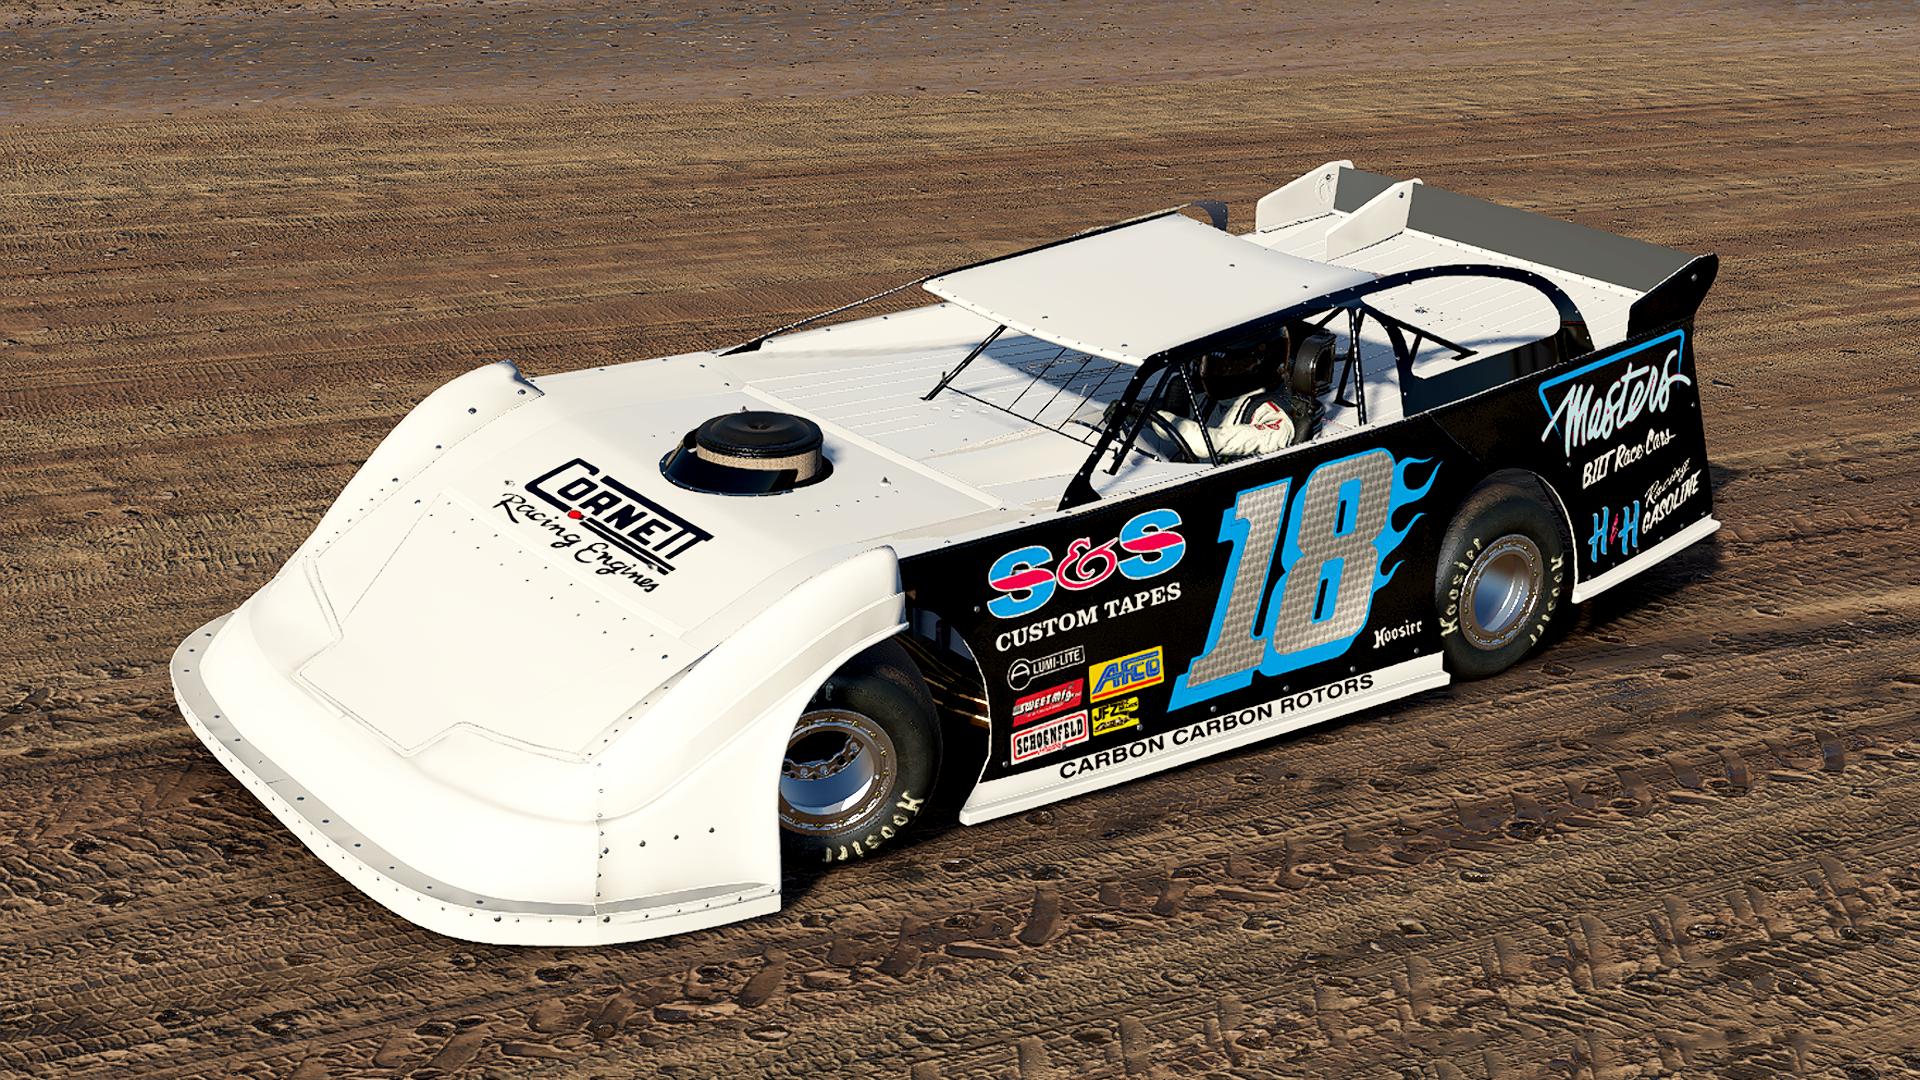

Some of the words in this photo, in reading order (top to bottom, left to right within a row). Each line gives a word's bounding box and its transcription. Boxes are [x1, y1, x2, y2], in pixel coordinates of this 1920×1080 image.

[1541, 349, 1691, 457] Masters
[1614, 444, 1644, 472] Race
[1645, 428, 1676, 455] Cars
[1645, 458, 1691, 508] Racing
[525, 458, 715, 560] CORNETT
[1642, 469, 1702, 534] GASOLINE
[493, 493, 582, 548] Racing
[574, 542, 660, 593] Engines
[987, 508, 1186, 619] S&S
[1168, 447, 1397, 713] 18
[1438, 537, 1483, 637] Hoosier
[995, 605, 1099, 652] CUSTOM
[1104, 582, 1182, 619] TAPES
[1372, 619, 1423, 649] Hoosier
[1032, 650, 1081, 675] LUMI-LITE
[1016, 718, 1084, 756] SCHOENFELD
[1059, 736, 1165, 779] CARBON
[1172, 705, 1273, 746] CARBON
[1280, 674, 1374, 717] ROTORS
[1094, 701, 1118, 722] JFZ
